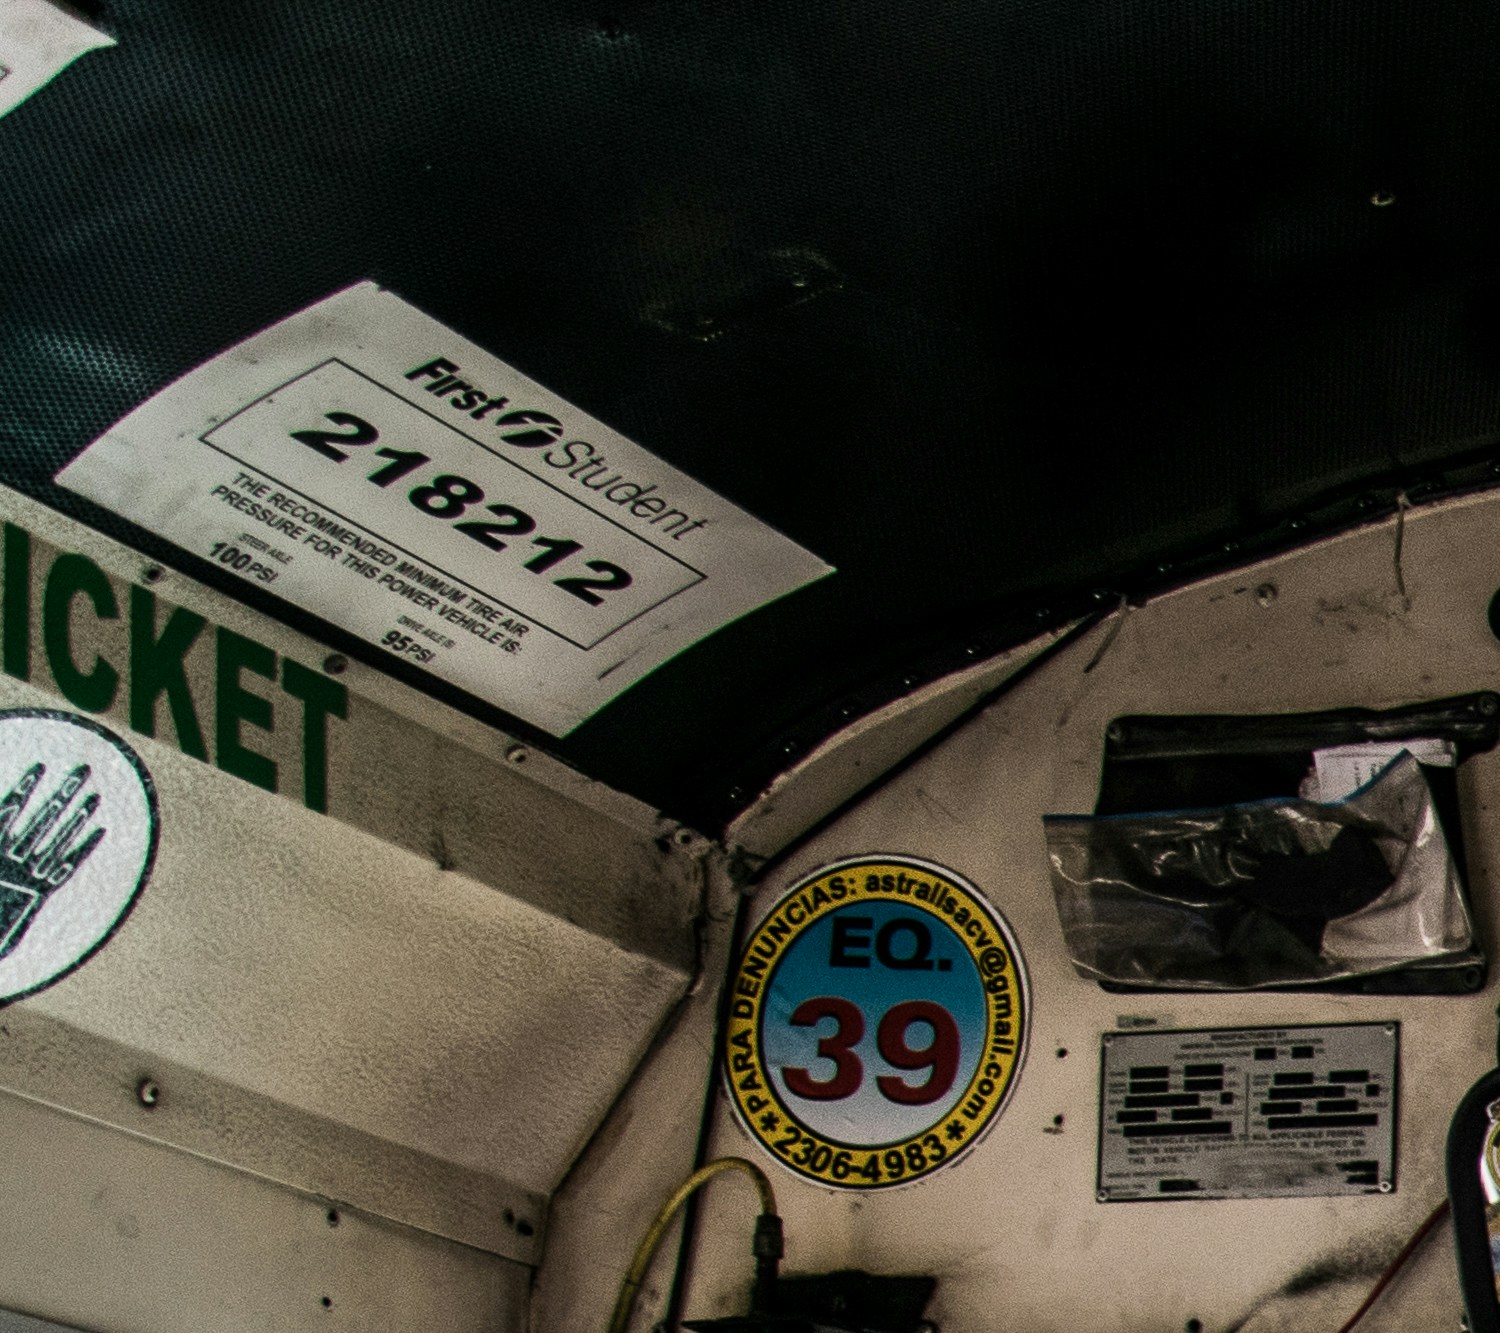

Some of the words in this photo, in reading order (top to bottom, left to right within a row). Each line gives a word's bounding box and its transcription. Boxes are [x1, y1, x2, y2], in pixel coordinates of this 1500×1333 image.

[290, 410, 636, 607] 218212
[406, 356, 508, 424] First
[543, 426, 709, 541] Student
[207, 542, 250, 571] 100
[248, 560, 278, 583] PSI
[211, 485, 307, 542] PRESSURE
[303, 535, 343, 560] FOR
[342, 552, 385, 581] THIS
[378, 573, 439, 610] POWER
[439, 599, 503, 644] VEHICLE
[232, 472, 262, 498] THE
[267, 491, 397, 567] RECOMMENDED
[396, 556, 467, 604] MINIMUM
[467, 598, 503, 624] TIRE
[501, 617, 530, 637] AIR
[381, 631, 411, 652] 95
[407, 645, 436, 664] PSI
[737, 876, 857, 1019] DENUNCIAS:
[829, 916, 953, 972] EQ.
[865, 872, 1014, 1121] astrallsacv@gmail.com
[734, 1026, 770, 1116] PARA
[781, 996, 962, 1106] 39
[773, 1126, 948, 1182] 2306-4983
